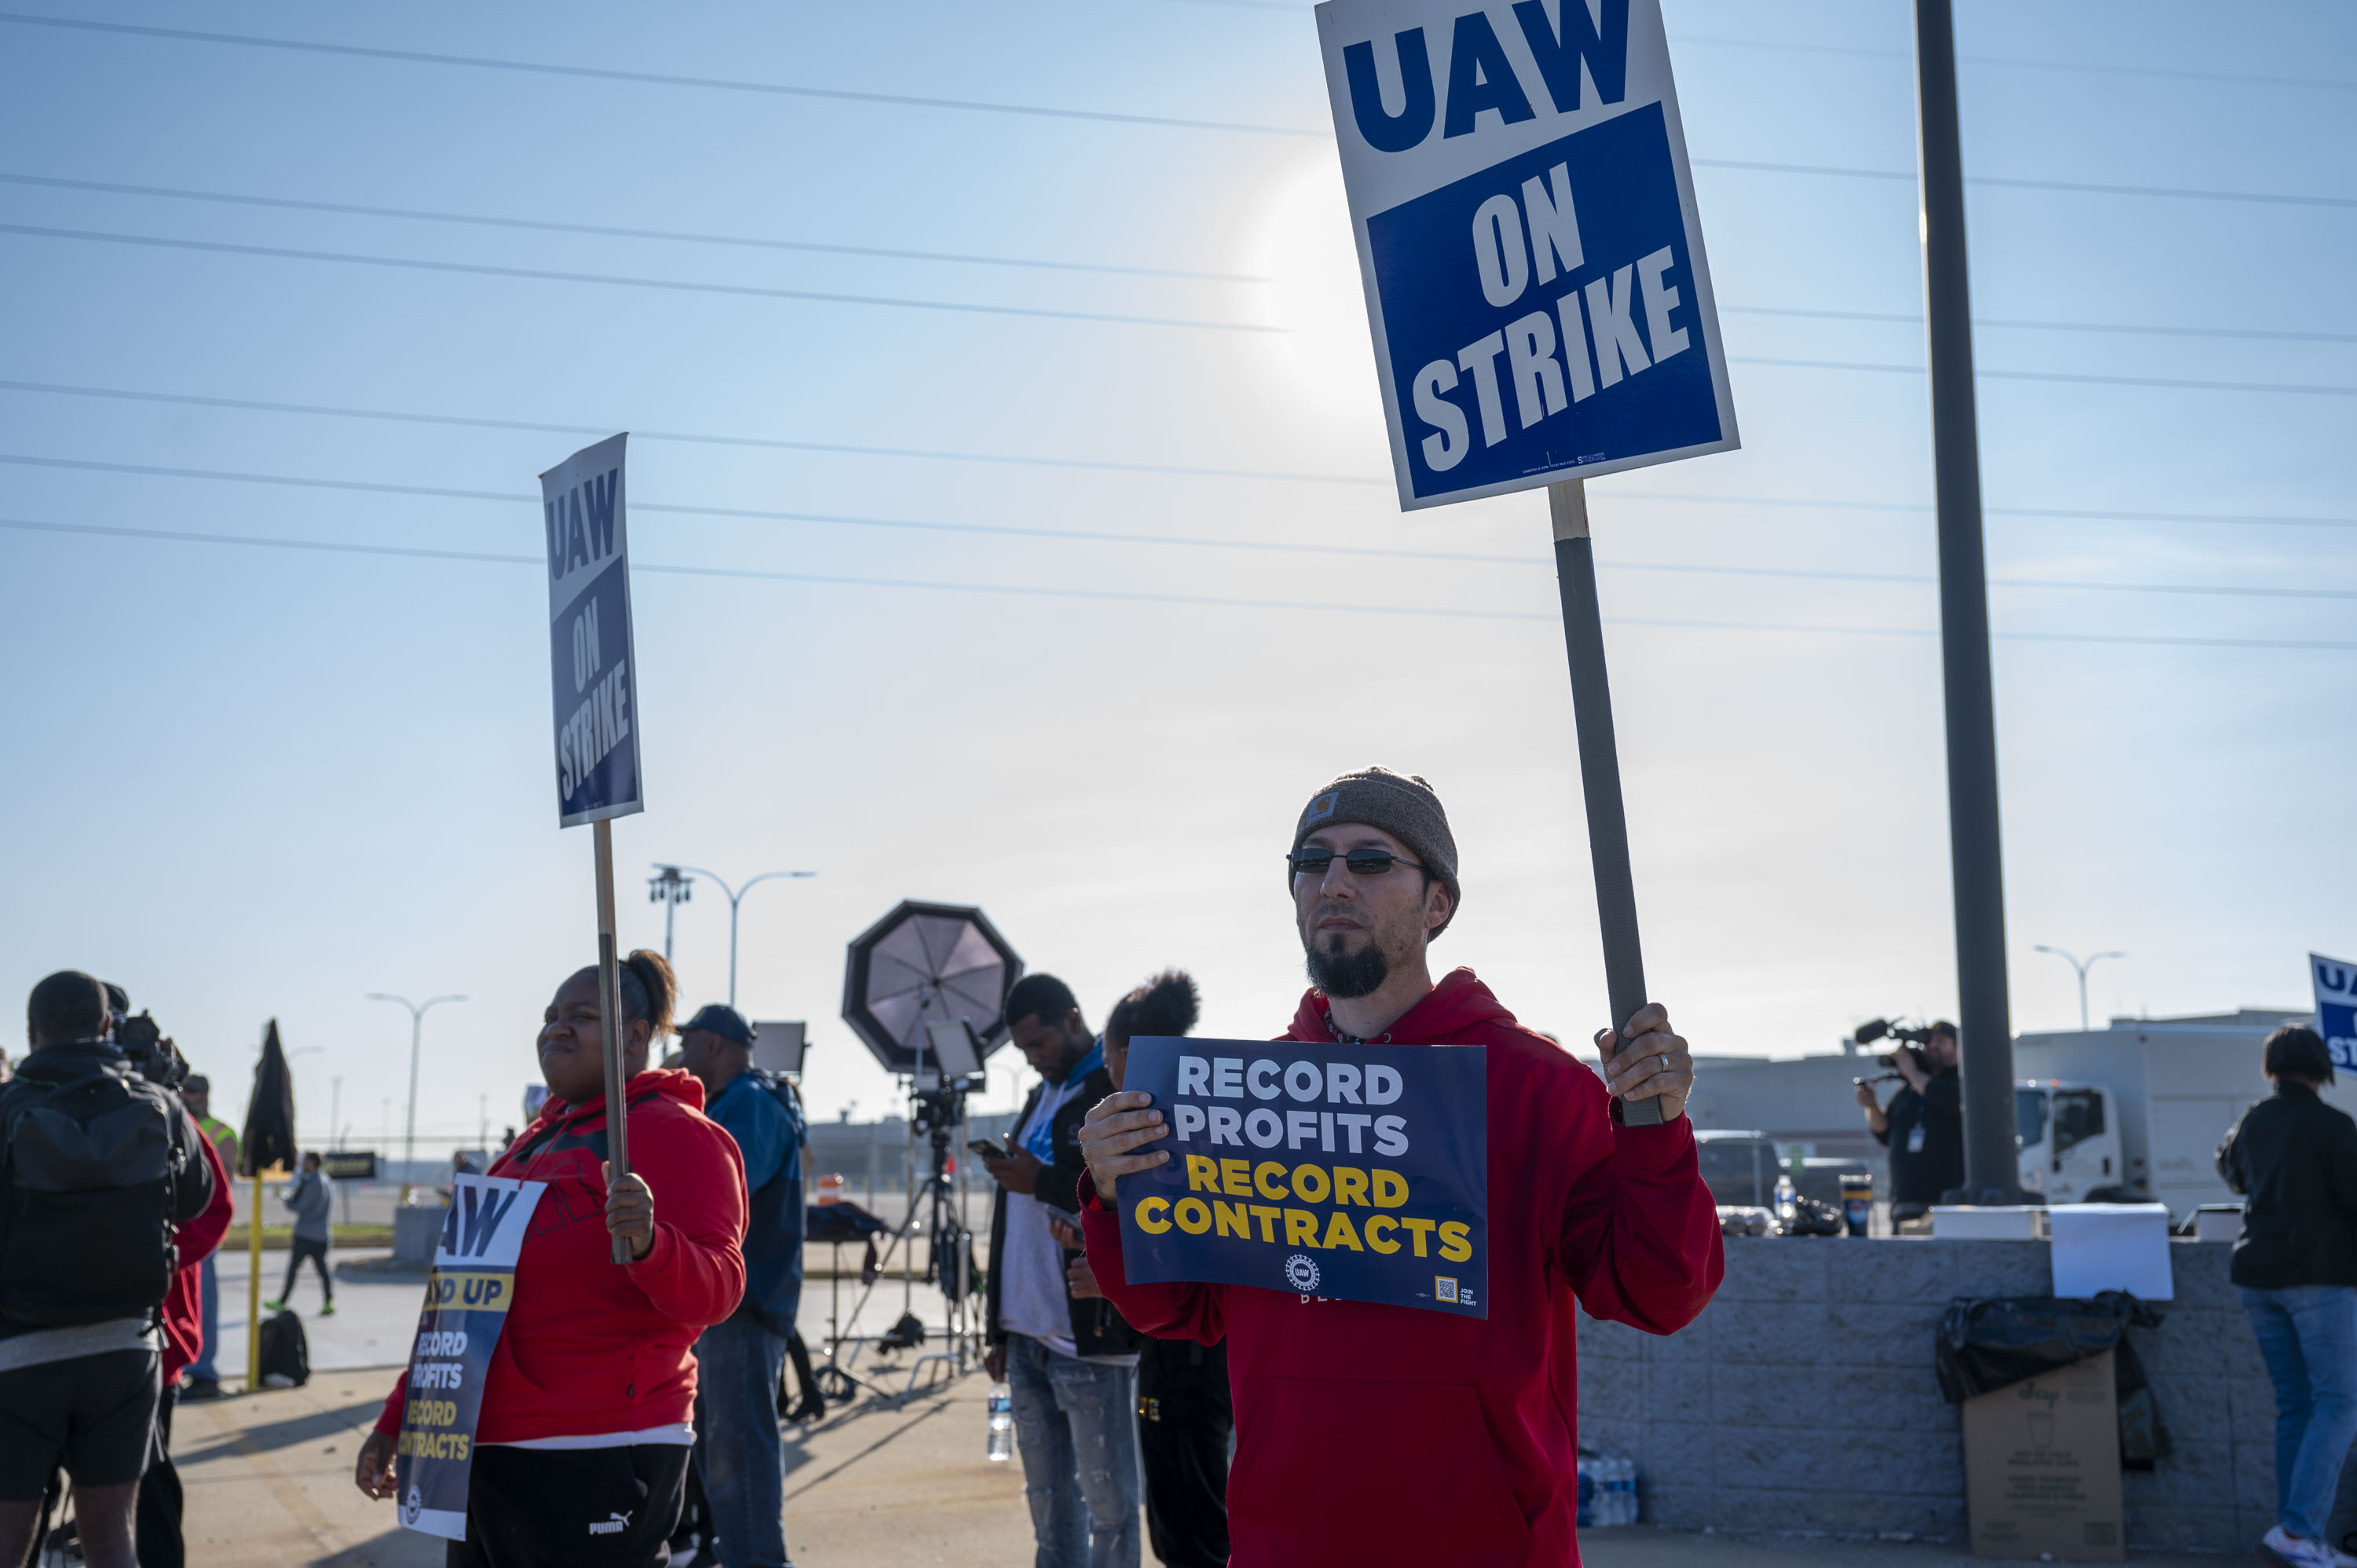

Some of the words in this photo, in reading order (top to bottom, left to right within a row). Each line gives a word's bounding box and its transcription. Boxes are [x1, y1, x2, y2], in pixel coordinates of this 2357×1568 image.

[1343, 0, 1630, 153] UAW
[1472, 161, 1585, 307] ON
[1413, 245, 1691, 472] STRIKE
[547, 468, 618, 581] UAW
[574, 595, 600, 693] ON
[559, 658, 629, 801] STRIKE
[1178, 1056, 1403, 1105] RECORD
[1174, 1104, 1409, 1156] PROFITS
[1186, 1154, 1409, 1208] RECORD
[1135, 1196, 1472, 1262] CONTRACTS
[463, 1278, 502, 1305] UP
[1295, 1268, 1309, 1277] UAW
[588, 1520, 624, 1536] PUMA
